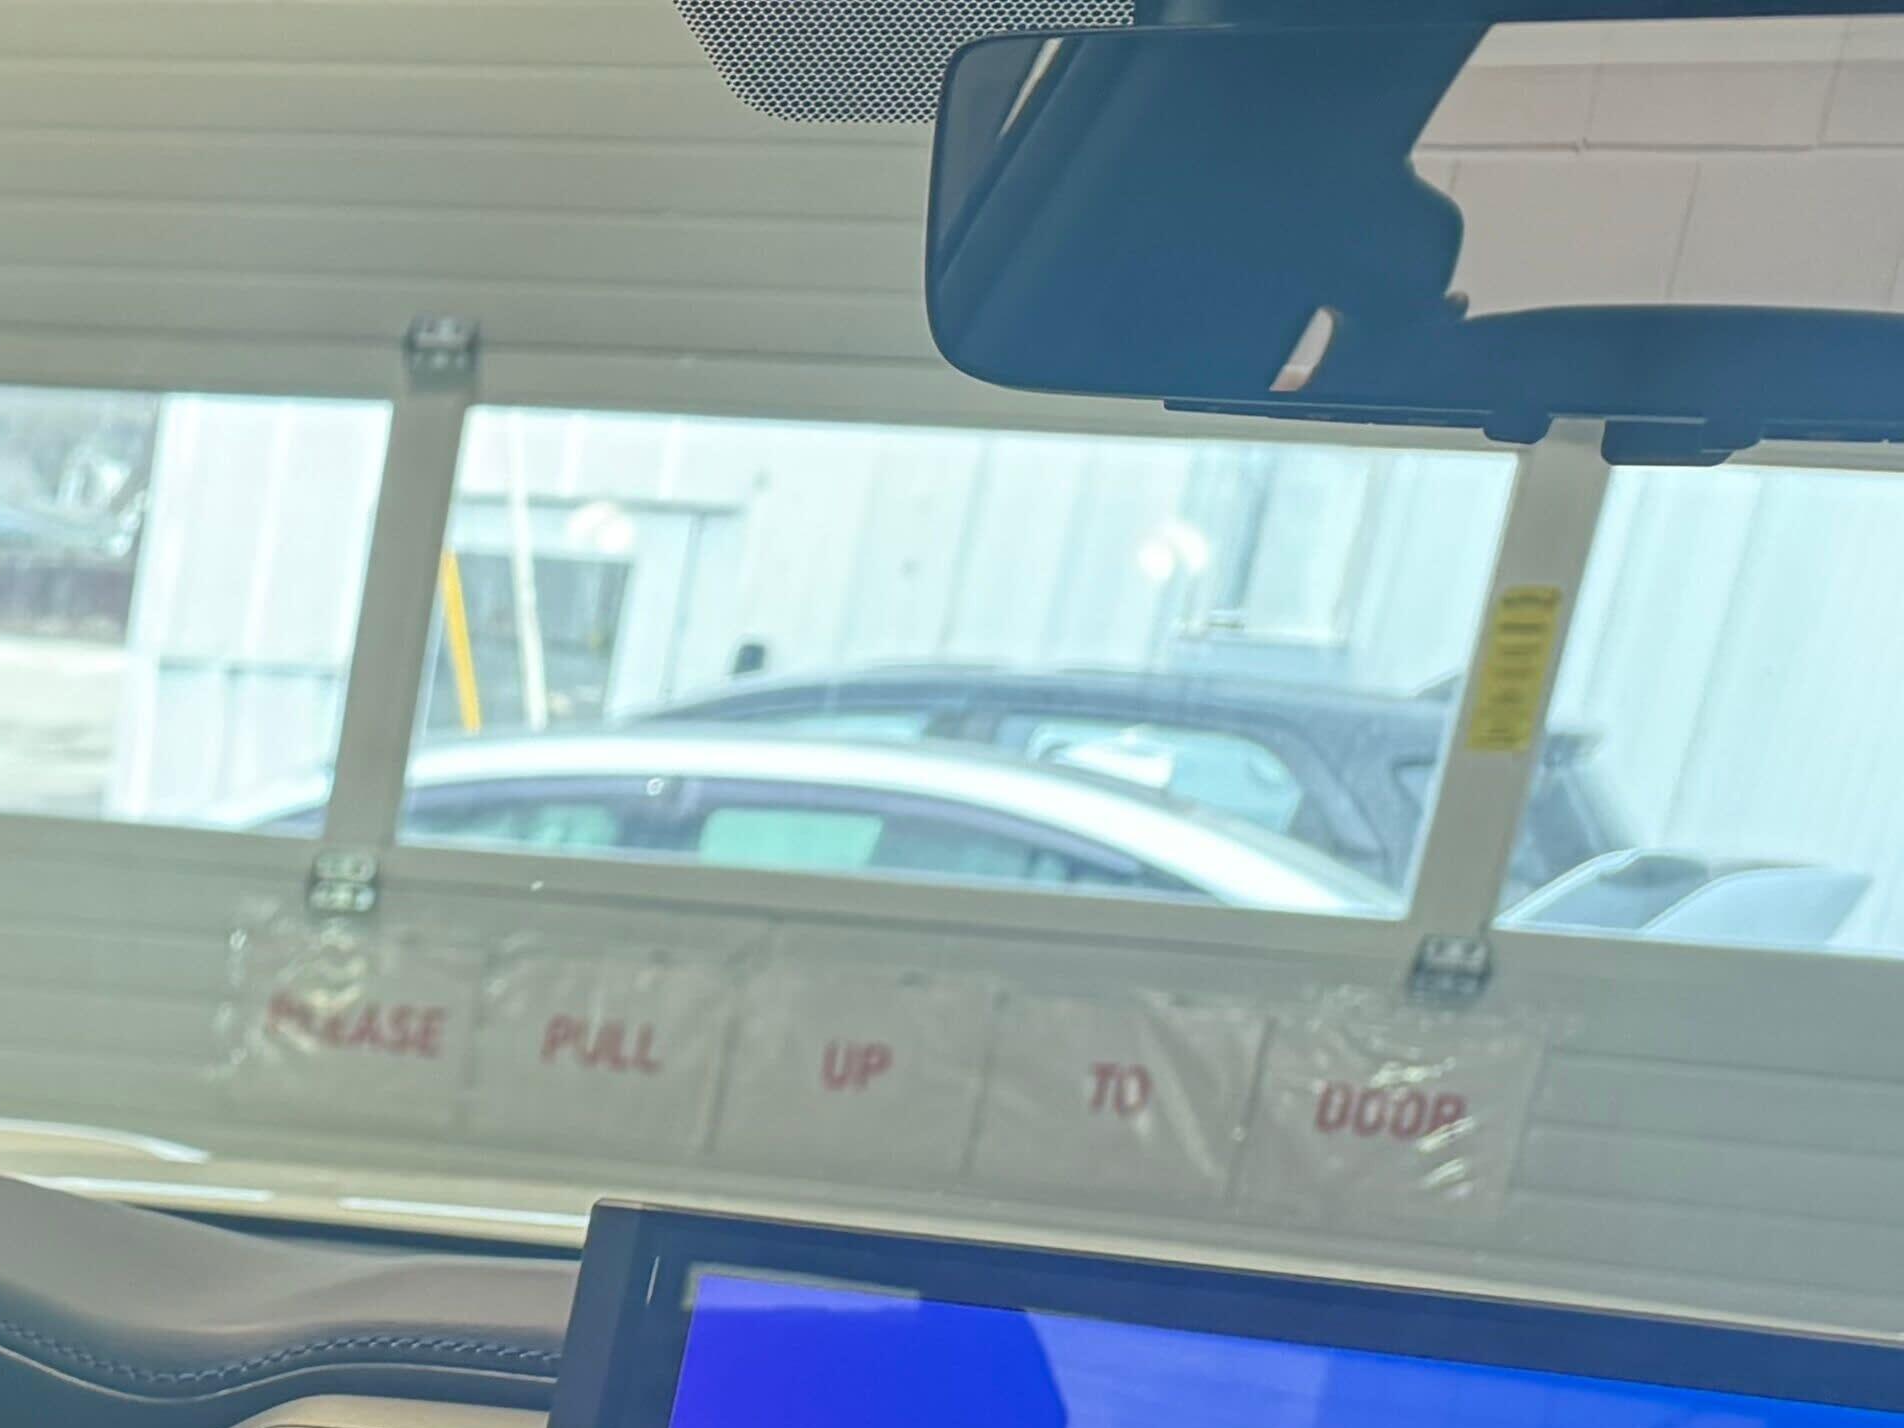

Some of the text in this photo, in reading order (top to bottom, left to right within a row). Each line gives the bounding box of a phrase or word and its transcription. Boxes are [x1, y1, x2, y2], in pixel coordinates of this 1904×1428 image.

[540, 1013, 664, 1077] PULL
[819, 1041, 894, 1091] UP
[1088, 1062, 1152, 1118] TO
